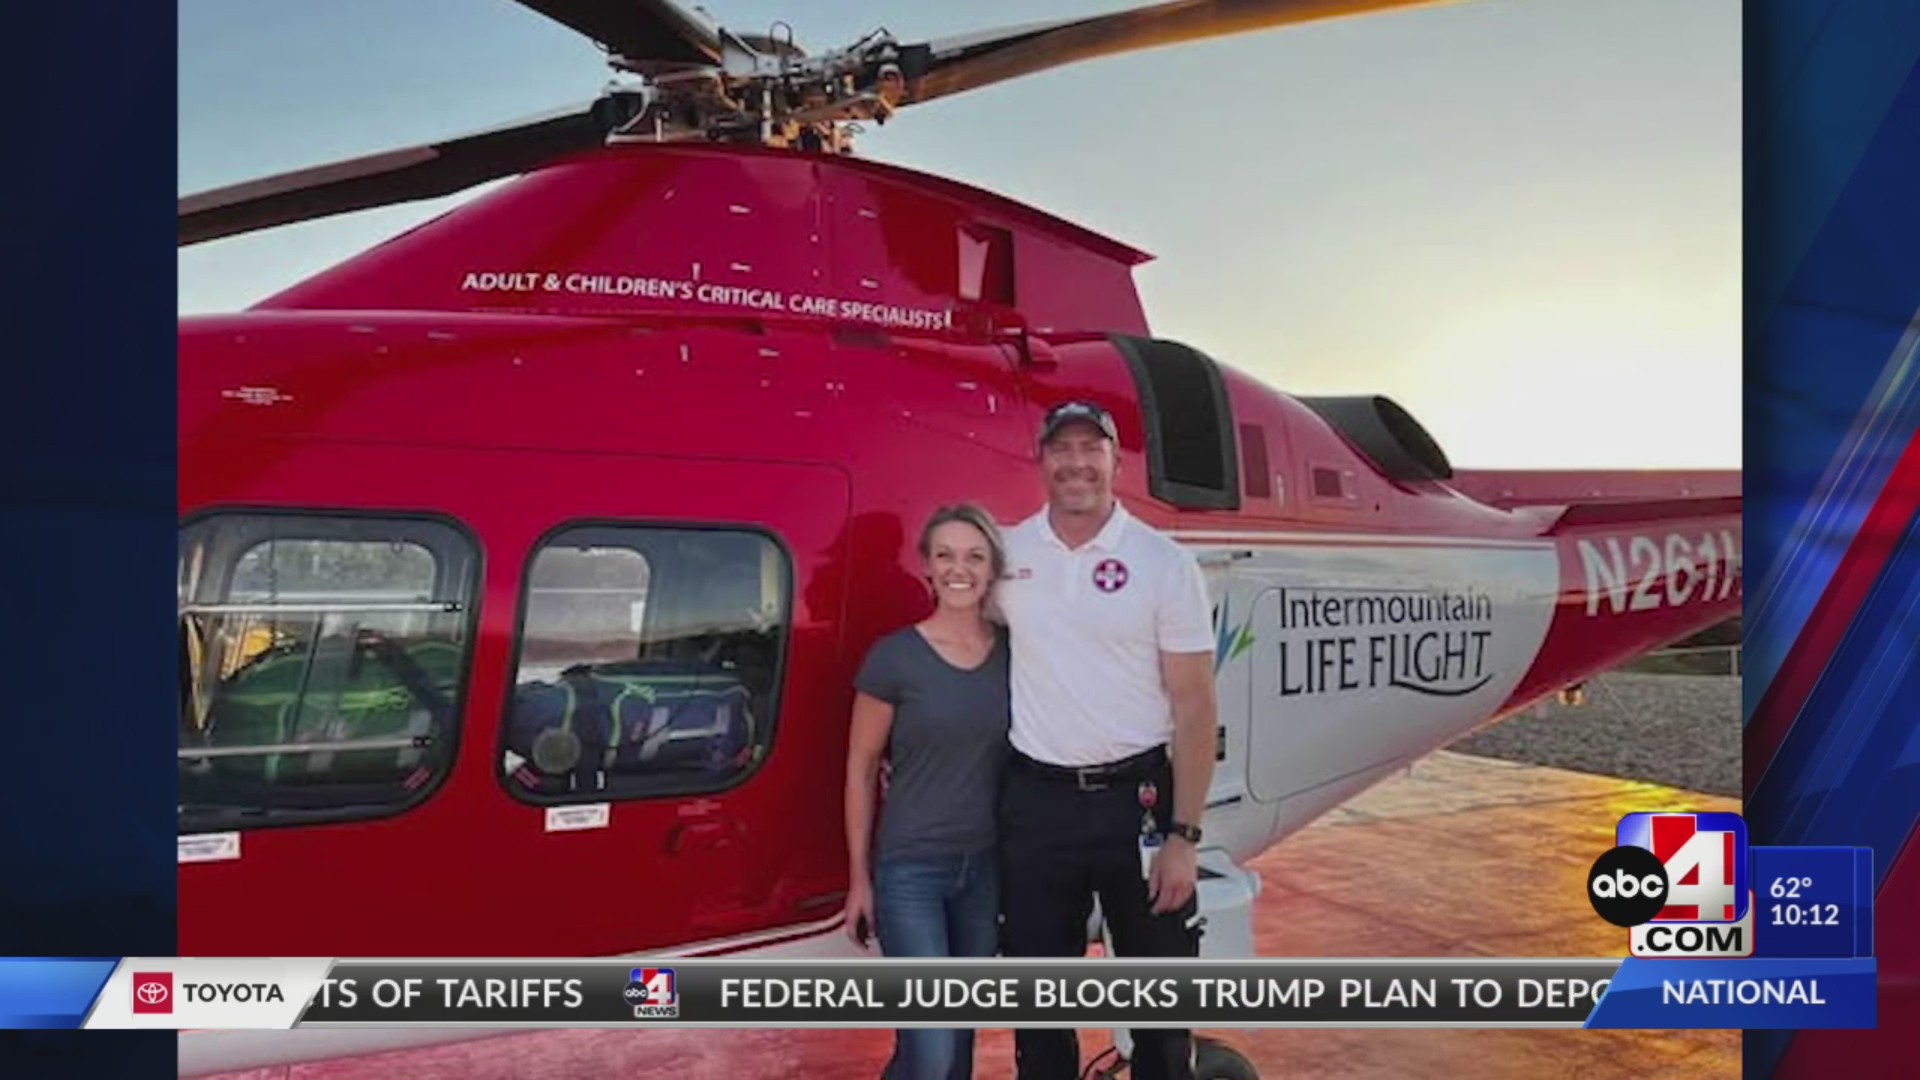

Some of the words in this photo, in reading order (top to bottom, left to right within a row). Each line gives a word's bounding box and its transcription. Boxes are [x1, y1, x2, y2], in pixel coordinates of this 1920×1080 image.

[461, 272, 540, 292] ADULT
[541, 272, 561, 291] &
[564, 274, 693, 300] CHILDREN'S
[696, 283, 785, 310] CRITICAL
[788, 294, 837, 317] CARE
[840, 303, 943, 331] SPECIALISTS
[1280, 587, 1492, 629] Intermountain
[1279, 638, 1359, 696] LIFE
[1368, 631, 1493, 696] FLIGHT
